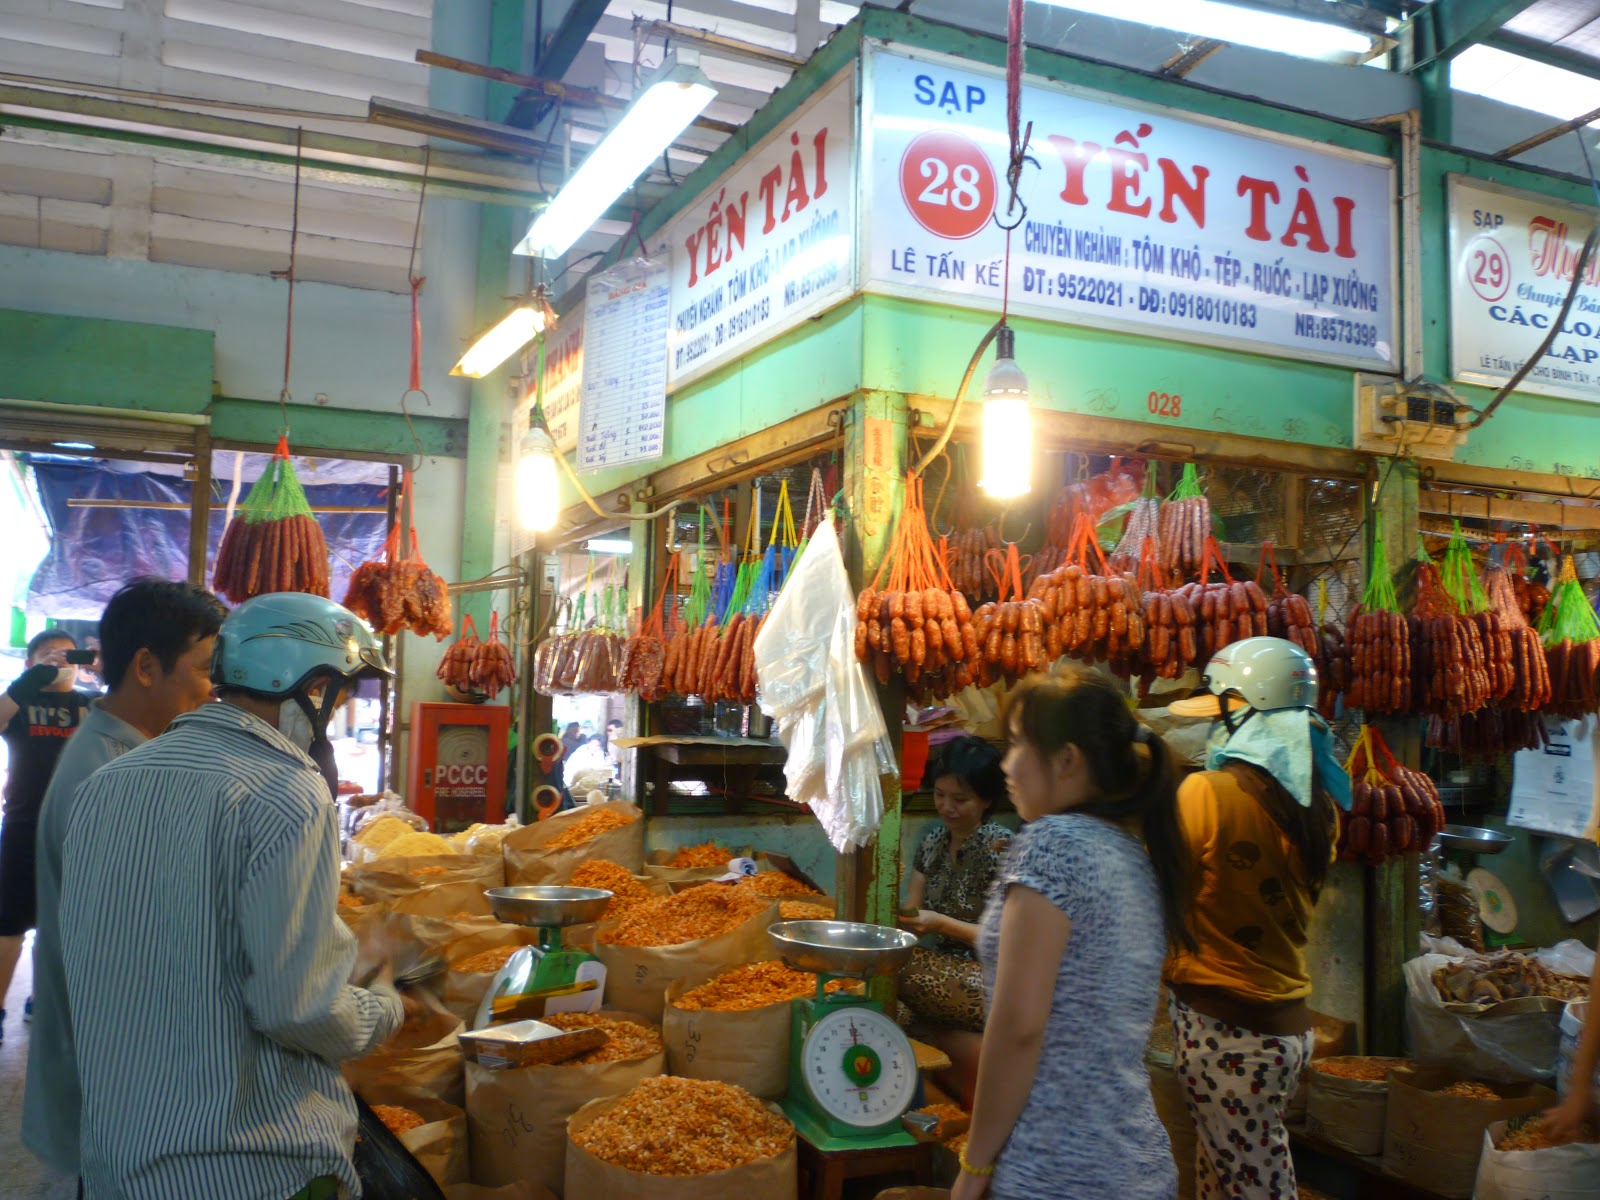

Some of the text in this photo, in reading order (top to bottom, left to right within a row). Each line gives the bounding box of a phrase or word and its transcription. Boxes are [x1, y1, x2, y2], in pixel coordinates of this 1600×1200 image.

[914, 75, 986, 114] SẠP
[918, 158, 981, 211] 28
[1048, 123, 1357, 258] YẾN TÀI
[685, 127, 828, 288] YẾN TÀI
[892, 248, 1003, 287] LÊ TẤN KẾ
[1024, 219, 1072, 259] CHUYÊN
[1132, 235, 1165, 274] TÔM
[1170, 244, 1201, 281] KHÔ
[1214, 251, 1242, 287] TÉP
[1253, 257, 1292, 297] RUỐC
[1303, 271, 1329, 309] LẠP
[1332, 268, 1378, 312] XƯỞNG
[1474, 250, 1503, 288] 29
[1489, 305, 1549, 329] CÁC
[1147, 391, 1182, 418] 028
[435, 765, 488, 784] PCCC
